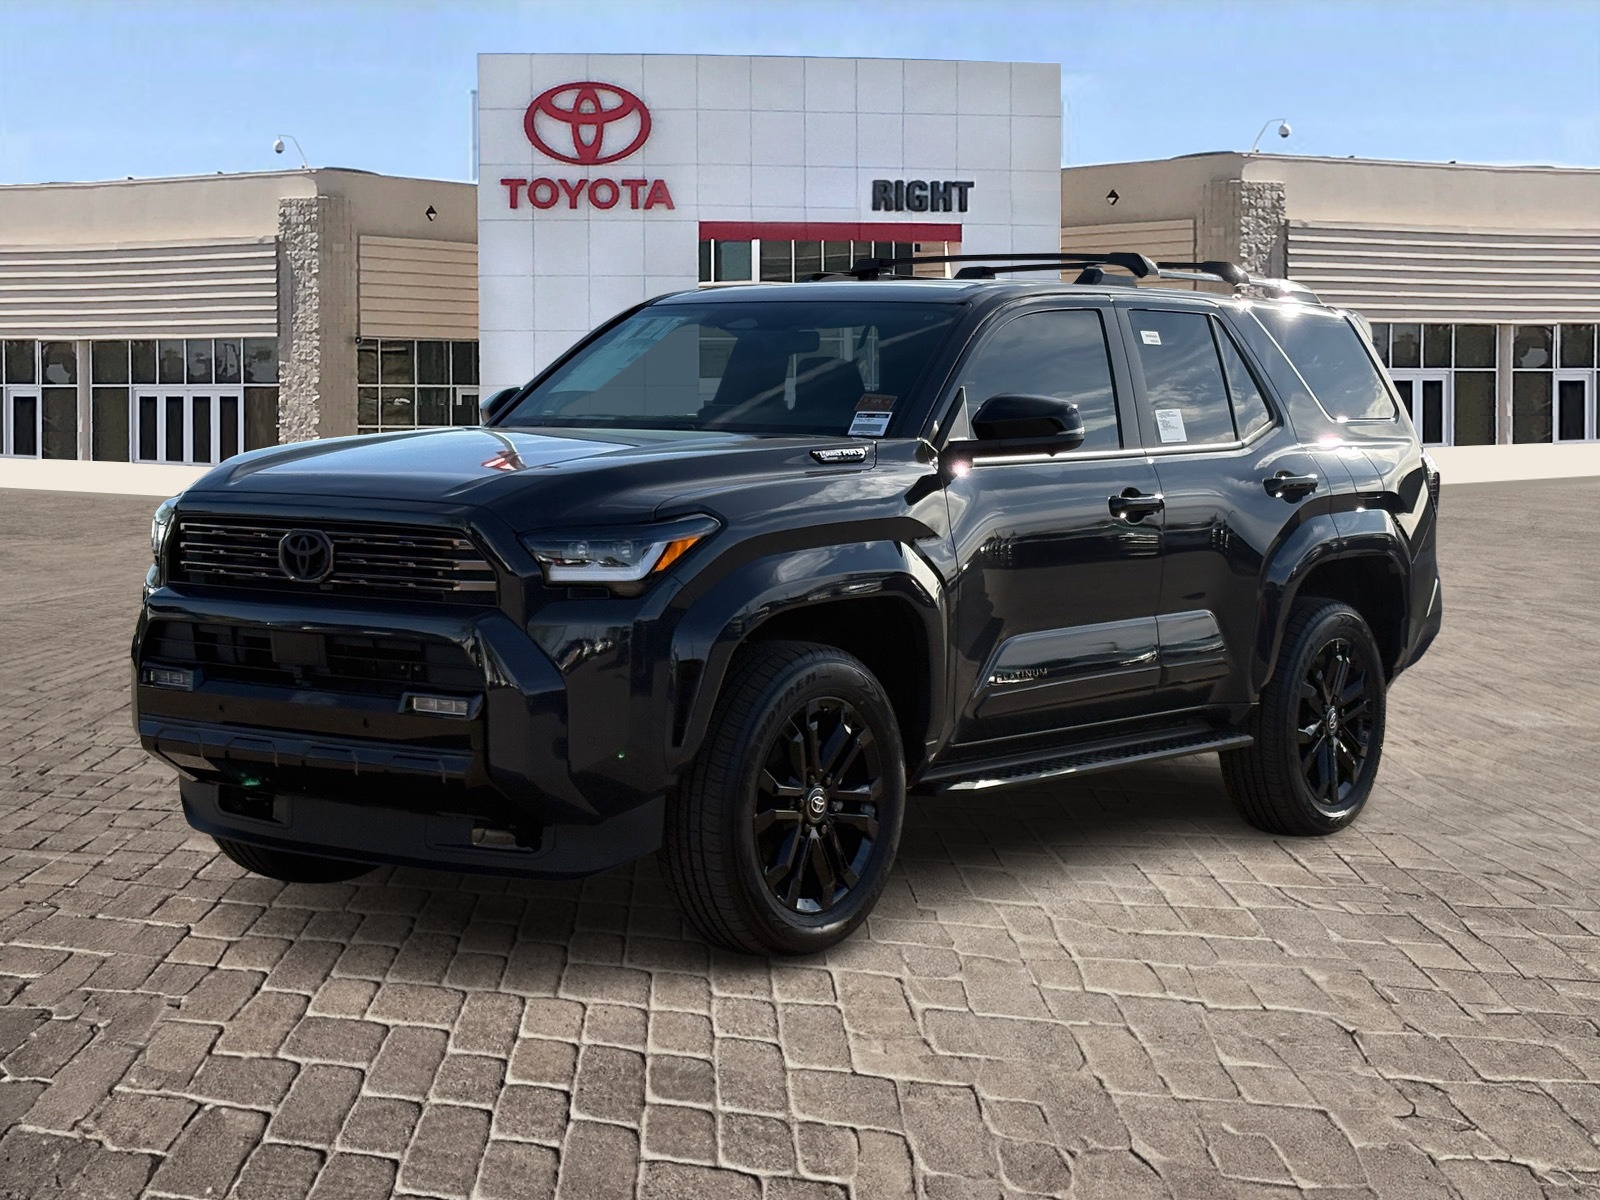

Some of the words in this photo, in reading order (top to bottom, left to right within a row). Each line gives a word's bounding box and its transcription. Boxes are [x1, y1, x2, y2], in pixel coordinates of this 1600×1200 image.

[500, 177, 675, 210] TOYOTA
[872, 179, 975, 212] RIGHT
[996, 667, 1048, 682] PLATINUM
